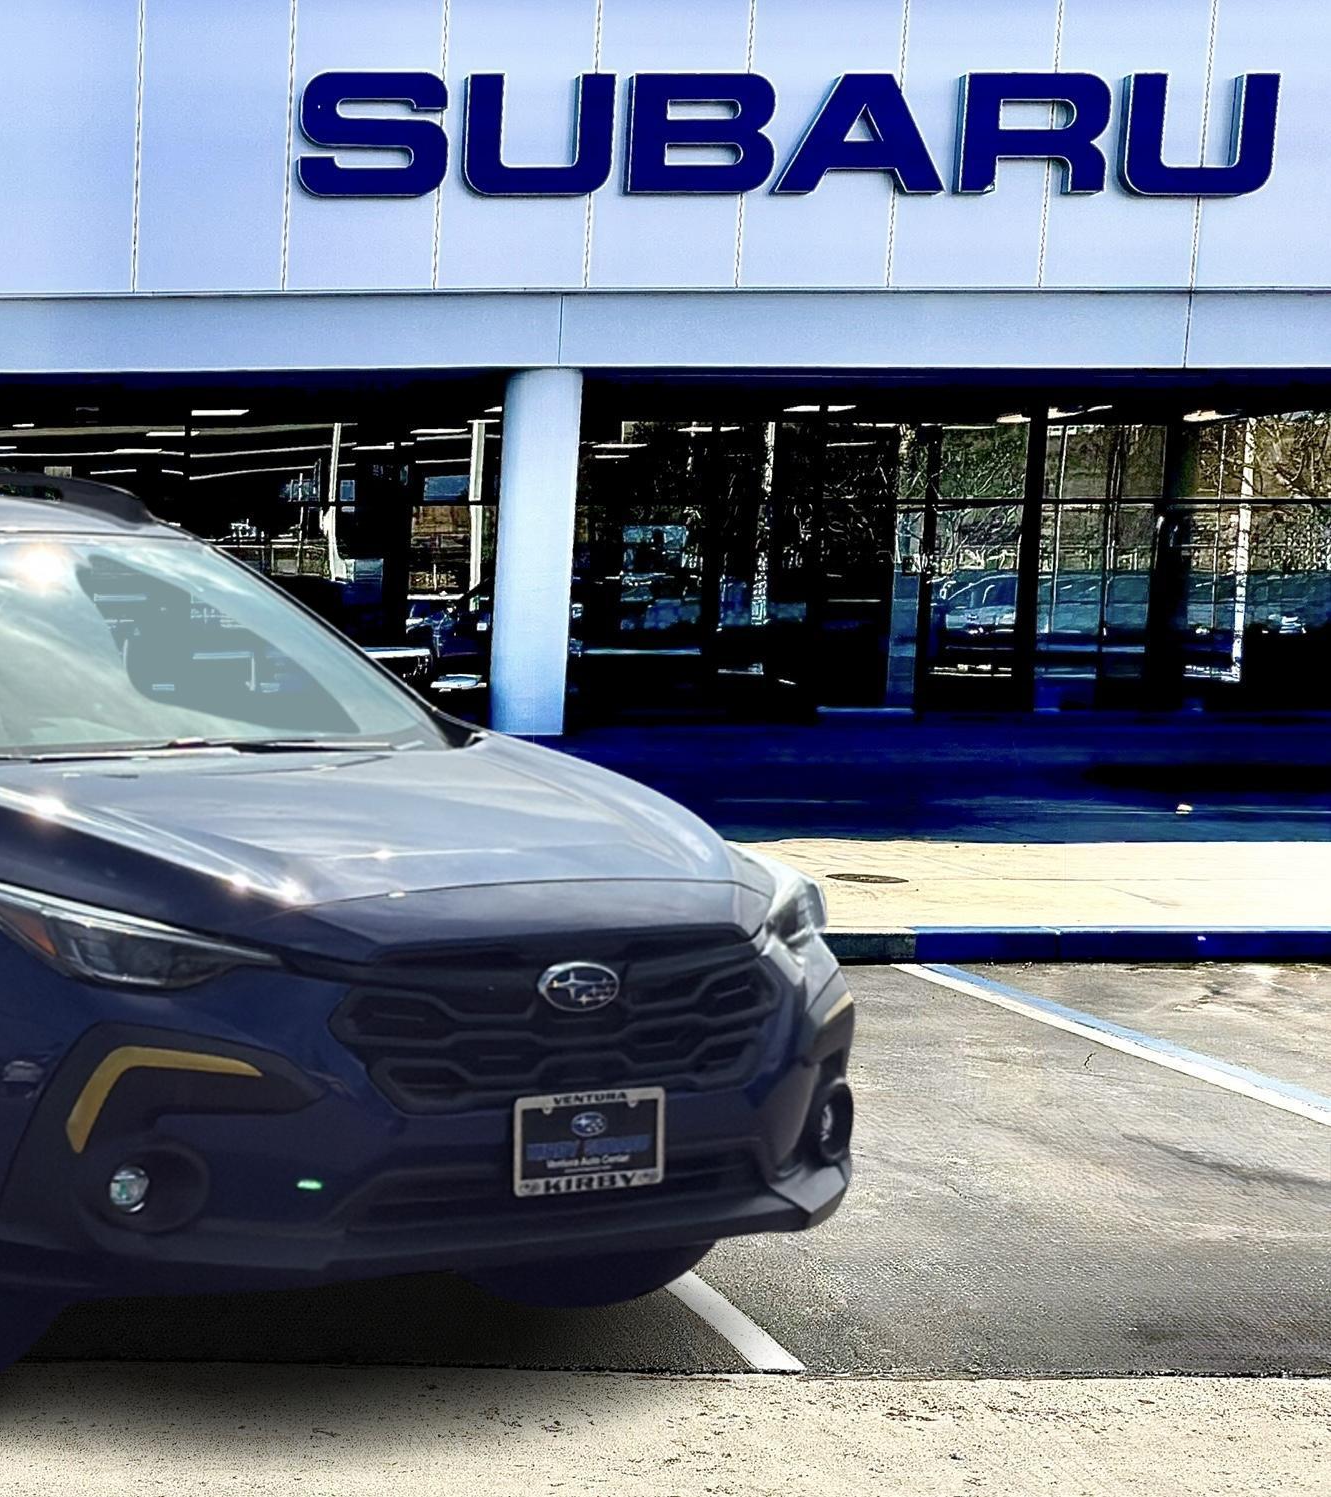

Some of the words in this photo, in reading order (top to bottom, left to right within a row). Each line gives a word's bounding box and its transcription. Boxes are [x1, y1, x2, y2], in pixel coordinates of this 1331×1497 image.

[297, 70, 1281, 197] SUBARU
[554, 1092, 627, 1104] VENTURA
[546, 1158, 579, 1168] Ventura
[580, 1156, 601, 1166] Auto
[601, 1154, 630, 1163] Center
[544, 1173, 635, 1193] KIRBY
